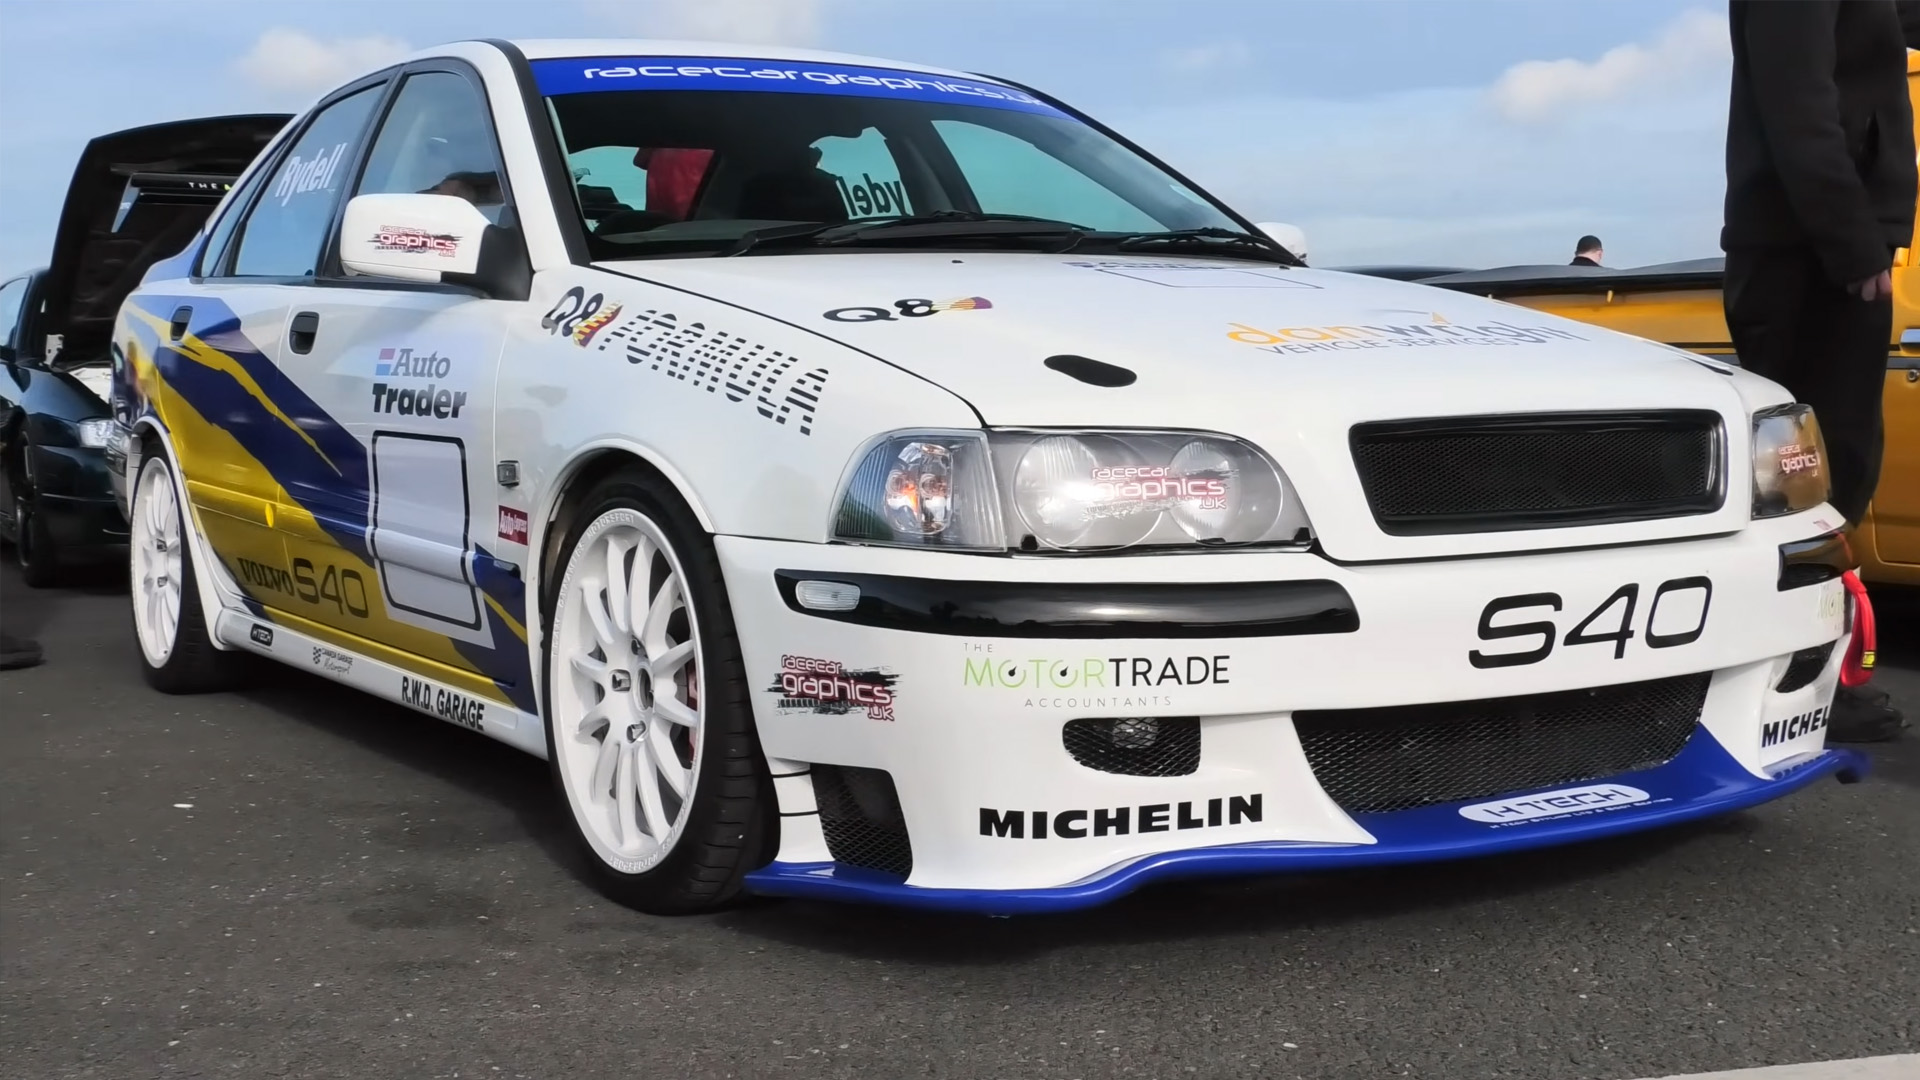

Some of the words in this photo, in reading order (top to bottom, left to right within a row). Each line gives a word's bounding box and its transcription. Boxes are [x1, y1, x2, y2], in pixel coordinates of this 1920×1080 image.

[188, 181, 218, 190] THE
[275, 142, 348, 207] Rydell
[380, 233, 456, 251] graphics
[541, 286, 604, 338] Q8
[823, 298, 941, 323] Q8
[1256, 339, 1391, 356] VEHICLE
[1388, 337, 1519, 348] SERVICES
[391, 348, 451, 379] Auto
[598, 309, 829, 437] FORMULA
[372, 383, 467, 419] Trader
[1092, 467, 1170, 479] racecar
[236, 556, 296, 597] VOLVO
[293, 557, 369, 619] S40
[1468, 575, 1713, 669] S40
[963, 642, 995, 653] THE
[782, 655, 842, 675] racecar
[402, 676, 434, 712] R.W.D.
[436, 689, 485, 731] GARAGE
[782, 673, 892, 705] graphics
[1024, 696, 1173, 708] ACCOUNTANTS
[979, 793, 1263, 841] MICHELIN
